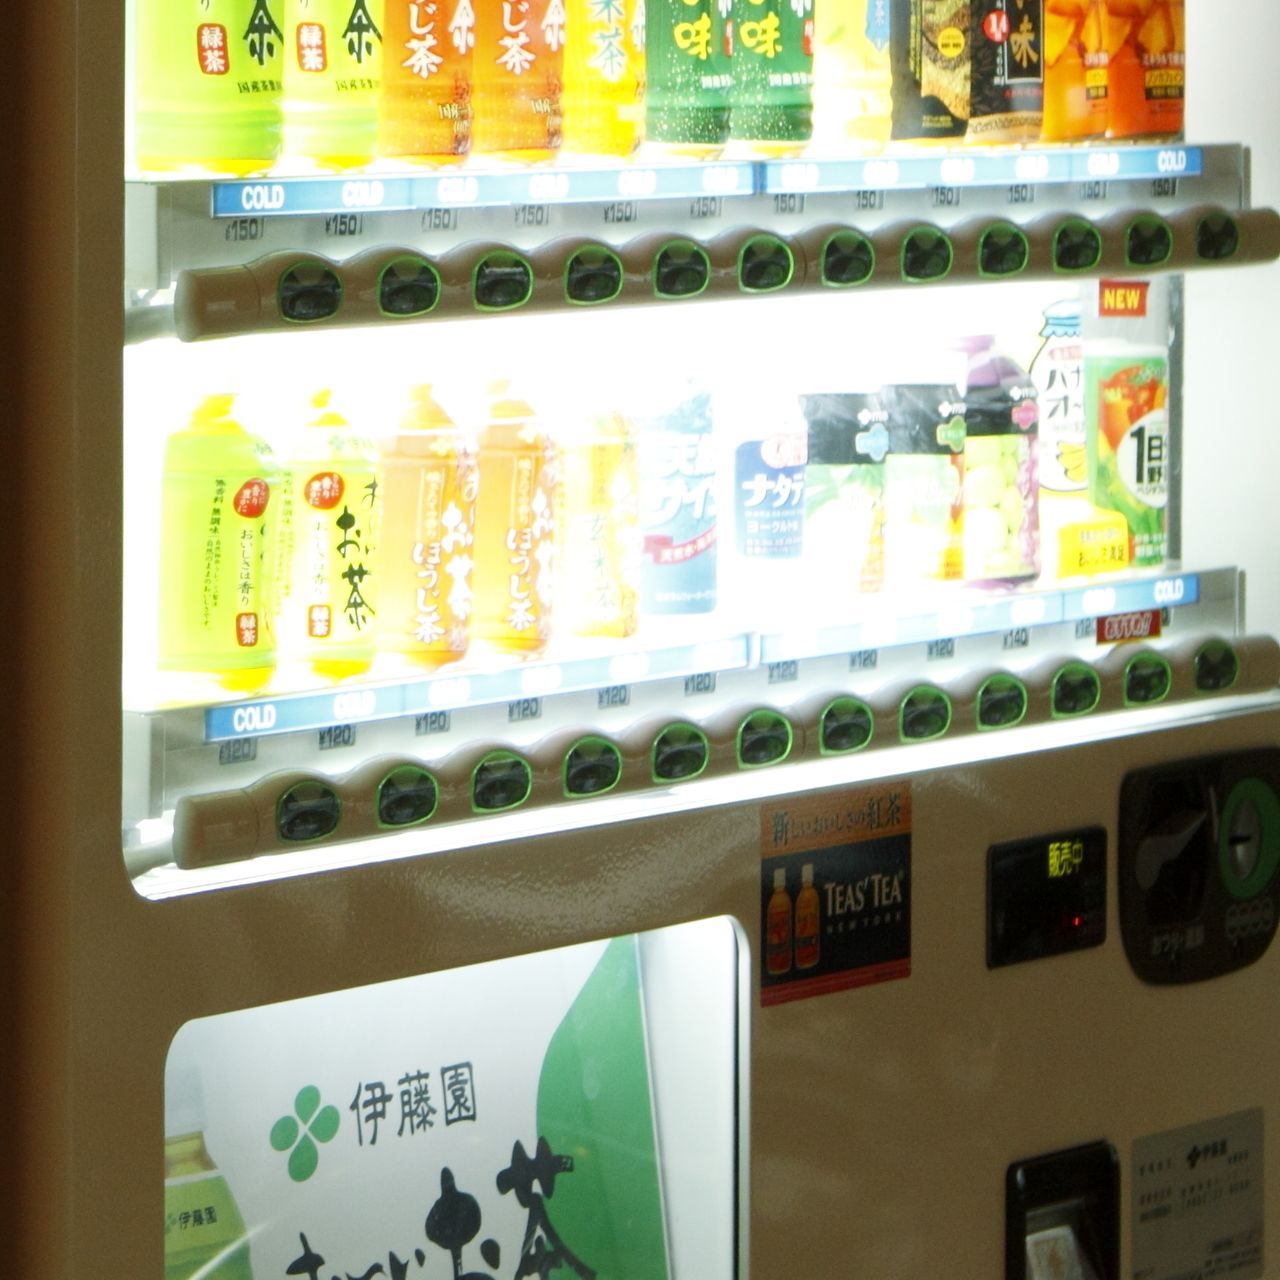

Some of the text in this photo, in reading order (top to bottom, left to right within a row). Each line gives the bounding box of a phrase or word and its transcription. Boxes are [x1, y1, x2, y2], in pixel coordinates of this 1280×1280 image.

[200, 25, 225, 73] 緑茶
[300, 23, 324, 71] 緑茶
[1157, 150, 1187, 171] COLD
[241, 185, 285, 210] COLD
[341, 180, 385, 208] COLD
[1103, 288, 1141, 311] NEW
[335, 504, 376, 631] お茶
[504, 527, 539, 633] ほうじ茶
[410, 541, 444, 646] ほうじ茶
[233, 703, 276, 733] COLD
[1047, 840, 1084, 880] 販売中
[871, 872, 903, 909] TEA
[349, 1060, 477, 1147] 伊藤園
[178, 1203, 218, 1230] 伊藤園
